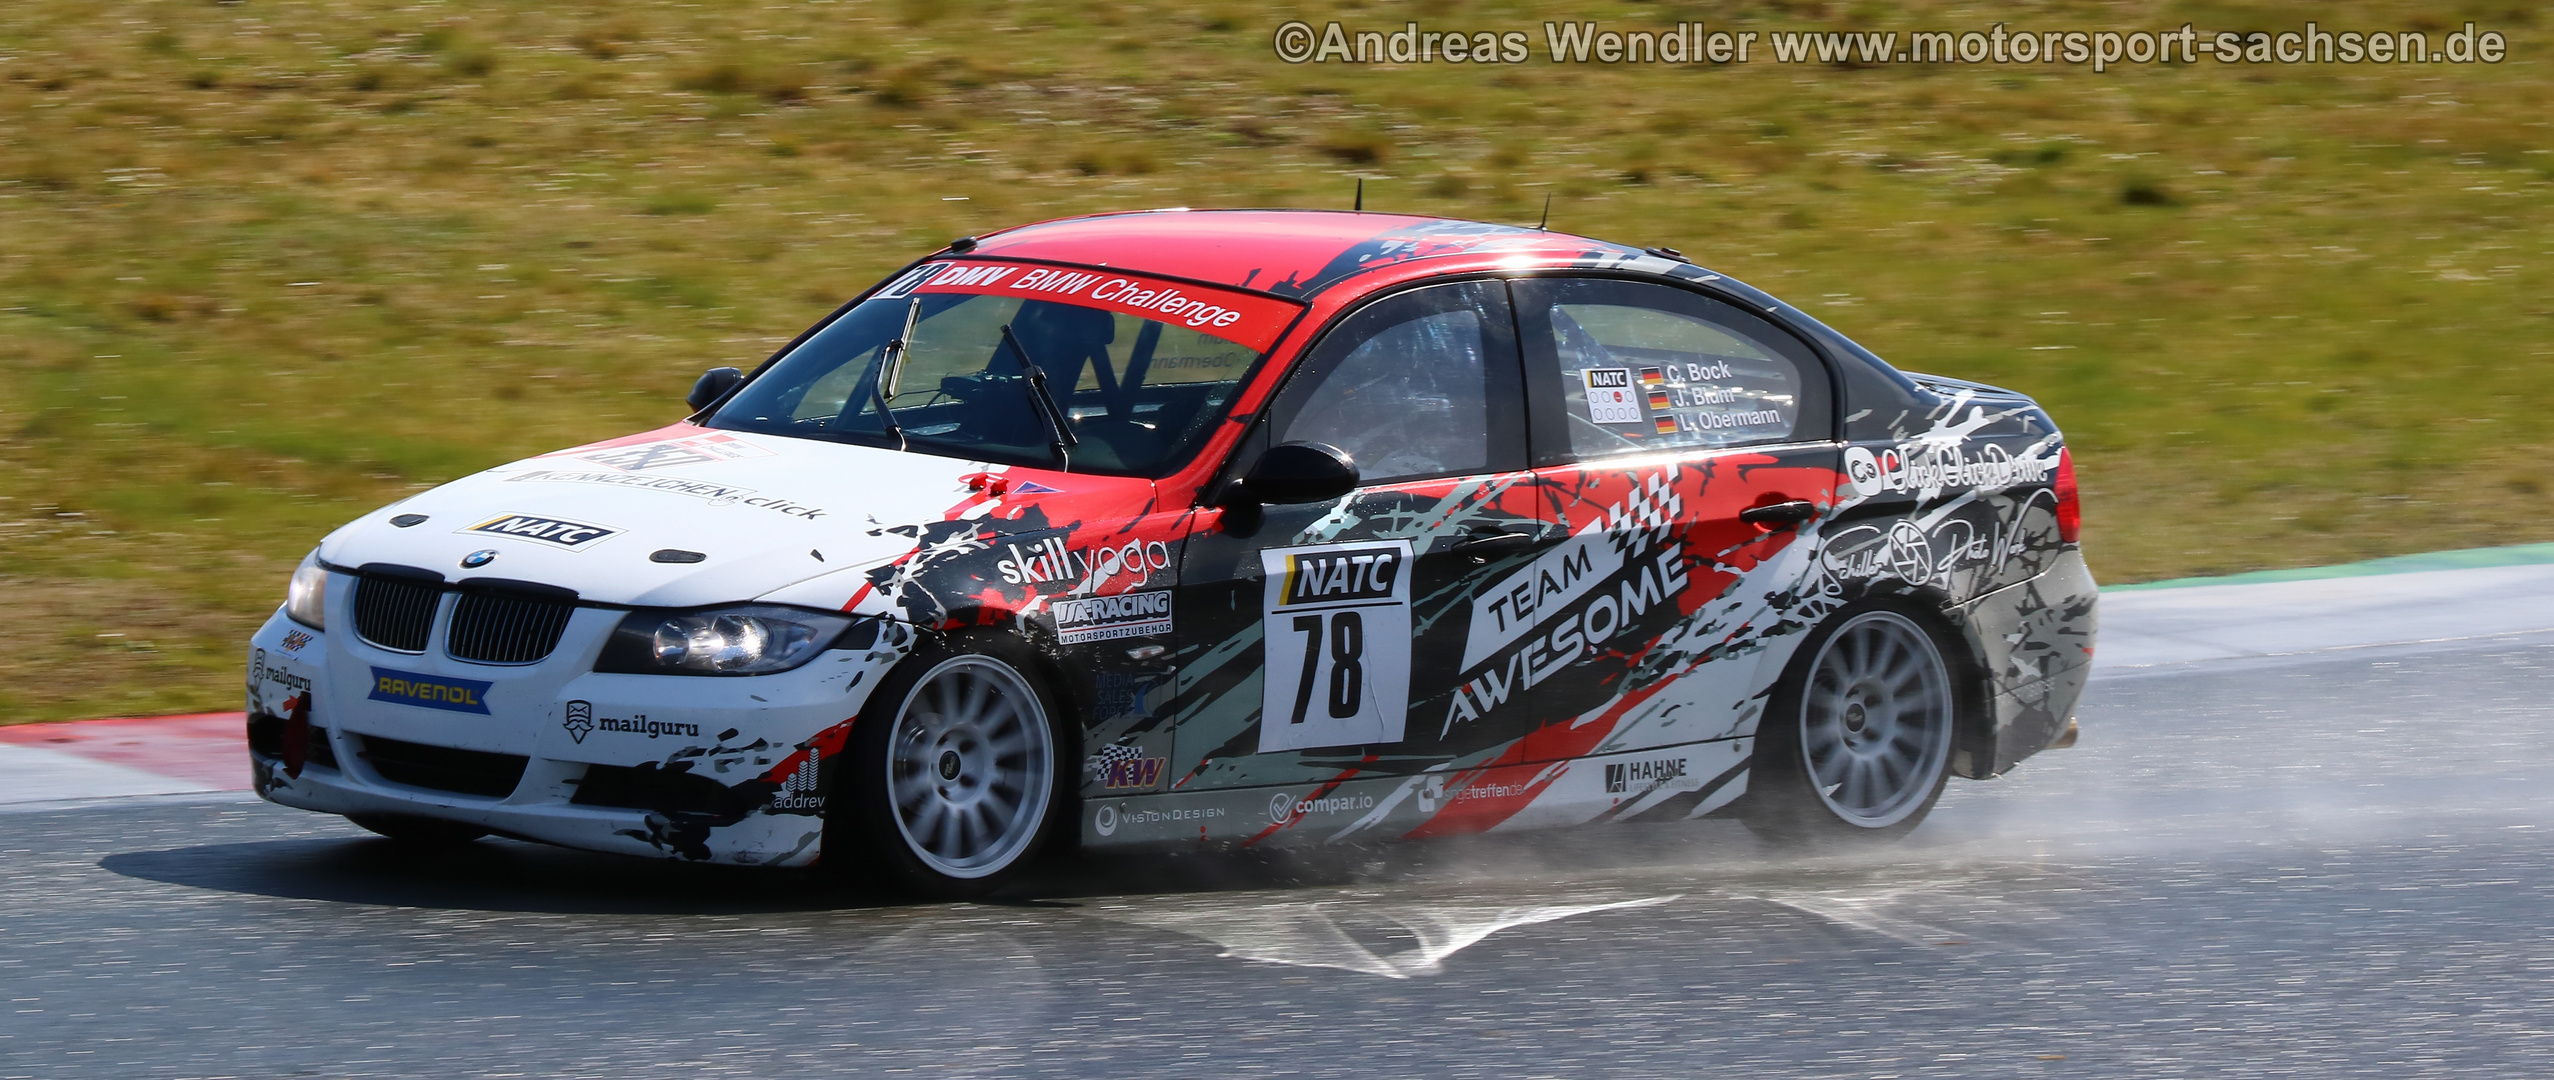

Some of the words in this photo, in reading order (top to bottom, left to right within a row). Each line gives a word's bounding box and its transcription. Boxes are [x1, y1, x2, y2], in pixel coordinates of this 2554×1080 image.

[928, 266, 1018, 287] DMV
[1009, 268, 1104, 295] BMW
[1091, 278, 1241, 328] Challenge
[1592, 371, 1627, 386] NATC
[1666, 364, 1686, 383] C.
[1687, 360, 1733, 382] Bock
[1674, 389, 1690, 408] J.
[1699, 409, 1781, 431] Obermann
[494, 517, 598, 543] NATC
[1297, 554, 1393, 598] NATC
[1488, 543, 1592, 633] TEAM
[1439, 542, 1688, 742] AWESOME
[265, 665, 312, 692] mailguru
[1290, 611, 1363, 724] 78
[378, 677, 478, 705] RAVENOL
[1095, 673, 1134, 689] MEDIA
[1097, 689, 1133, 705] SALES
[599, 715, 699, 738] mailguru
[1106, 757, 1166, 788] KW
[1630, 758, 1687, 780] HAHNE
[774, 792, 825, 809] addrev
[1296, 792, 1373, 814] compar.io
